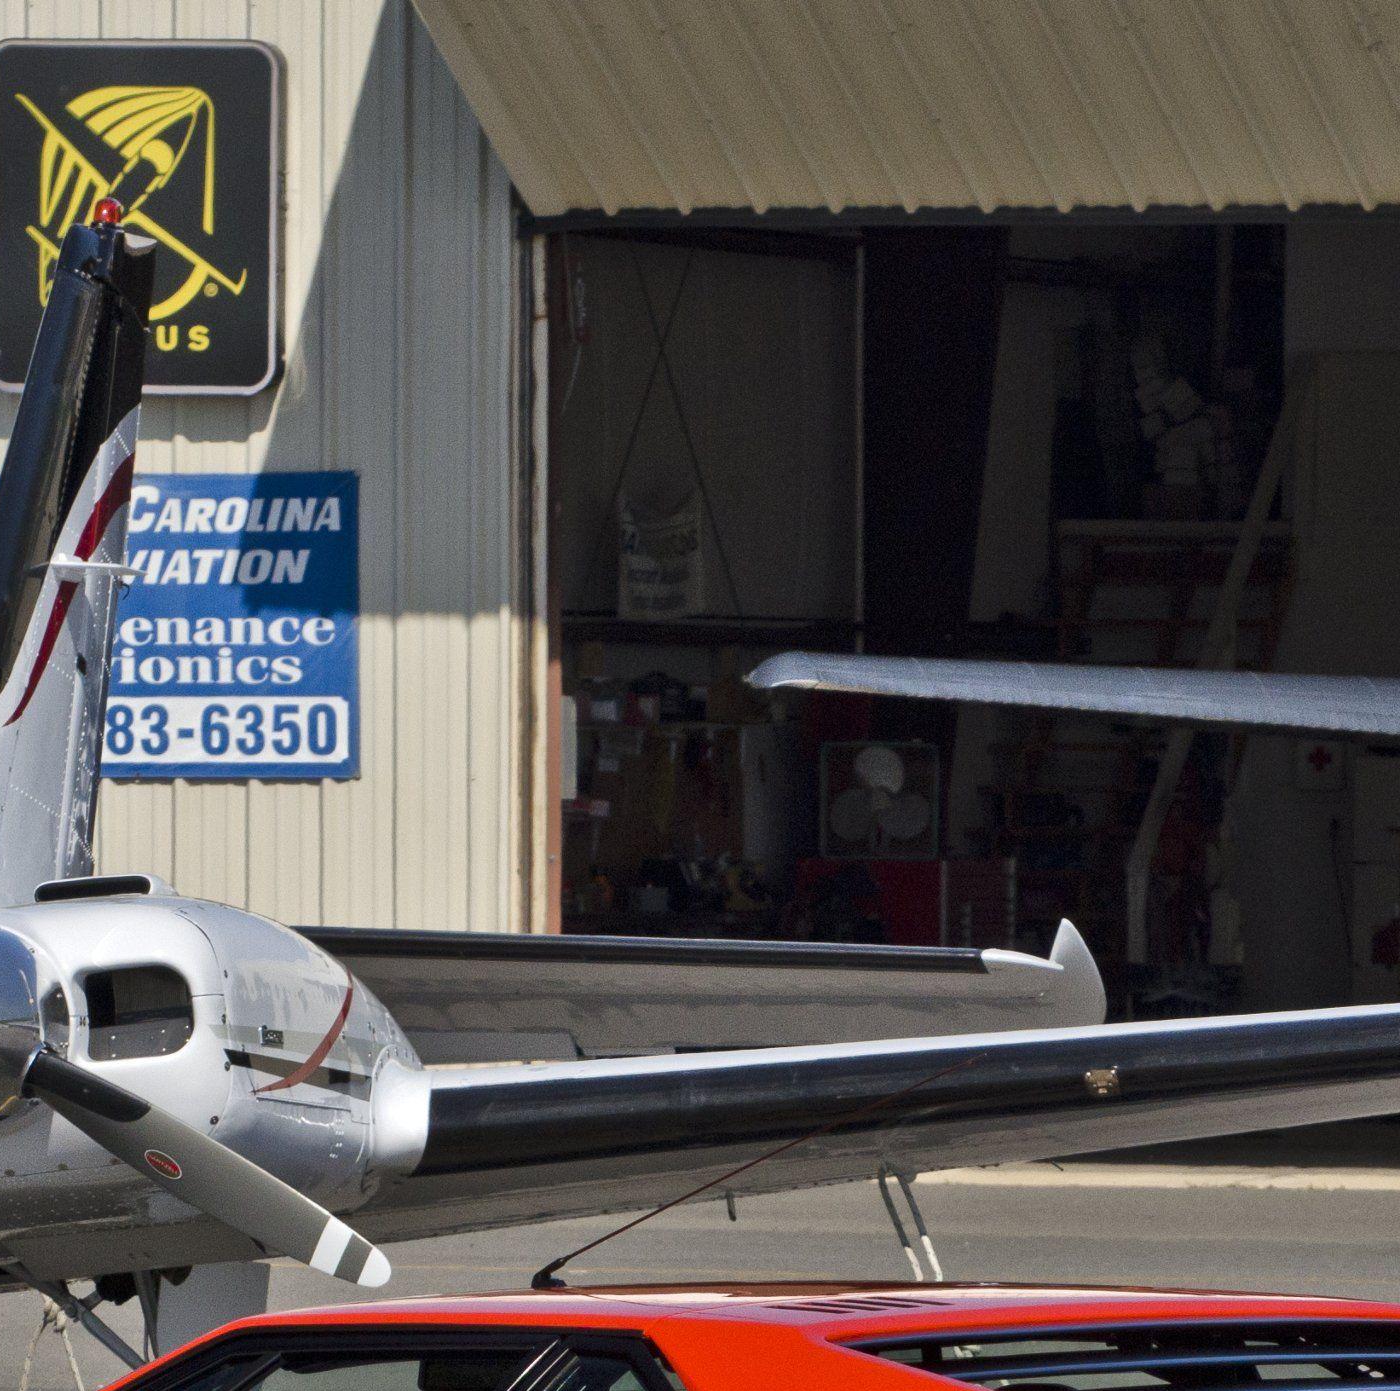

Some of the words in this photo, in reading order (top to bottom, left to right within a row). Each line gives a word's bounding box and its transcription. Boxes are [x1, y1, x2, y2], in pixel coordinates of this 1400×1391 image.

[156, 325, 210, 352] US
[122, 549, 311, 585] VIATION
[114, 616, 336, 646] enance
[111, 647, 303, 684] ionics
[106, 703, 338, 756] 83-6350
